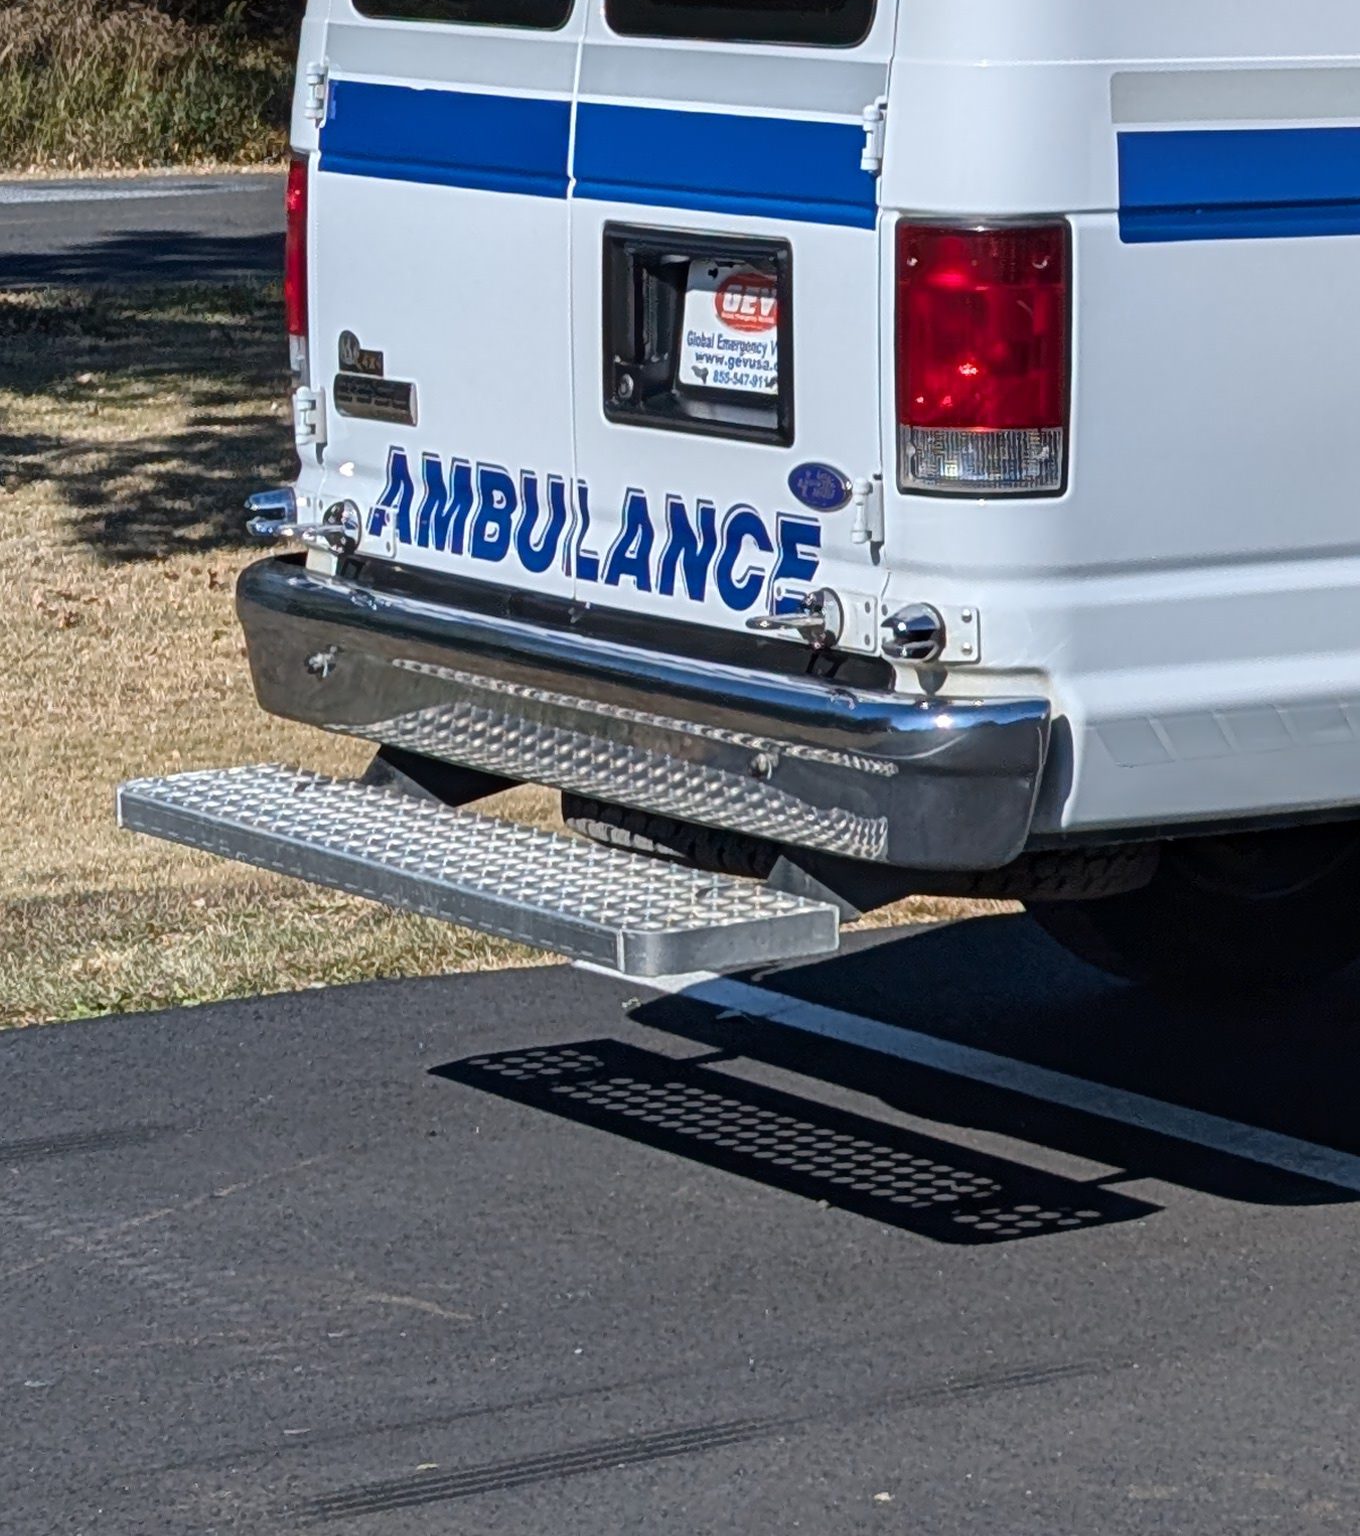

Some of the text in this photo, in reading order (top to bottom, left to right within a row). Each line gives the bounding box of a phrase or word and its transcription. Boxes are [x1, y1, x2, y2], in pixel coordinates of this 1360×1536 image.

[686, 330, 715, 349] Global
[717, 334, 768, 359] Emergency
[368, 446, 822, 616] AMBULANCE
